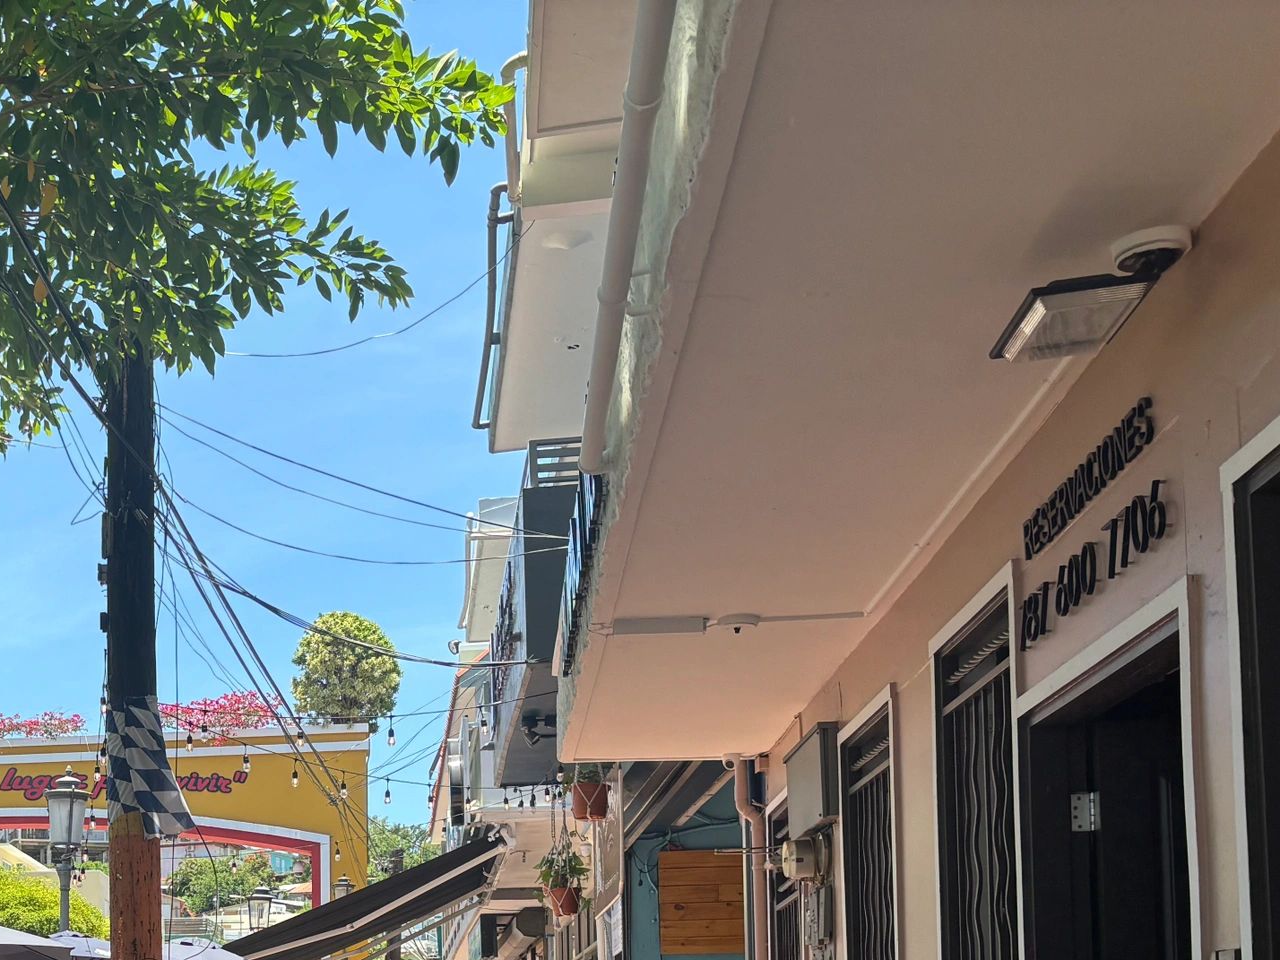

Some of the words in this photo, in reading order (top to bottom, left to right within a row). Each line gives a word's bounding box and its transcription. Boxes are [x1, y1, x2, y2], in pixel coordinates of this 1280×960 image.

[1023, 396, 1155, 561] RESERVACIONES
[1055, 541, 1097, 616] 600
[1101, 479, 1167, 579] 7706
